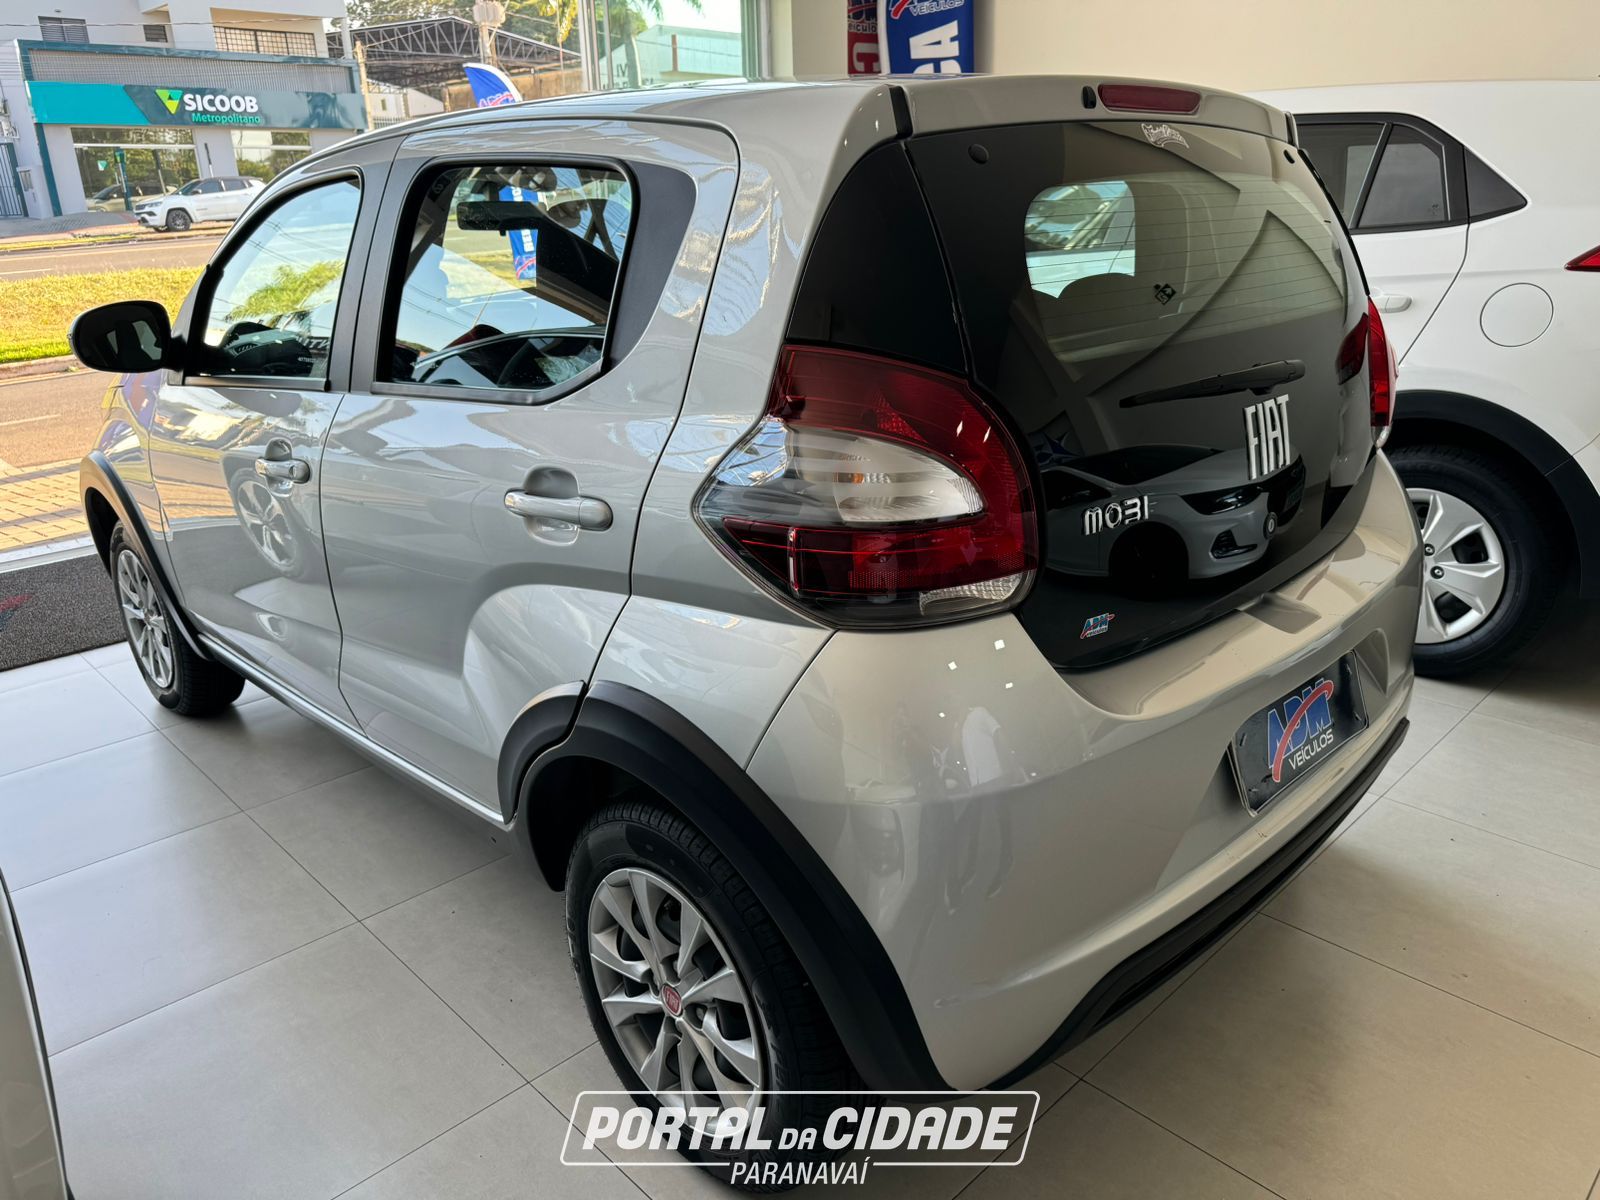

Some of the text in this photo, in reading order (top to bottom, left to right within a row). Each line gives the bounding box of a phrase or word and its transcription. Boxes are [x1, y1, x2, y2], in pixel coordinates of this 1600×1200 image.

[183, 93, 259, 113] SICOOB
[191, 112, 261, 124] Metropolitano
[1243, 394, 1291, 480] FIAT
[1288, 729, 1335, 771] VEÍCULOS
